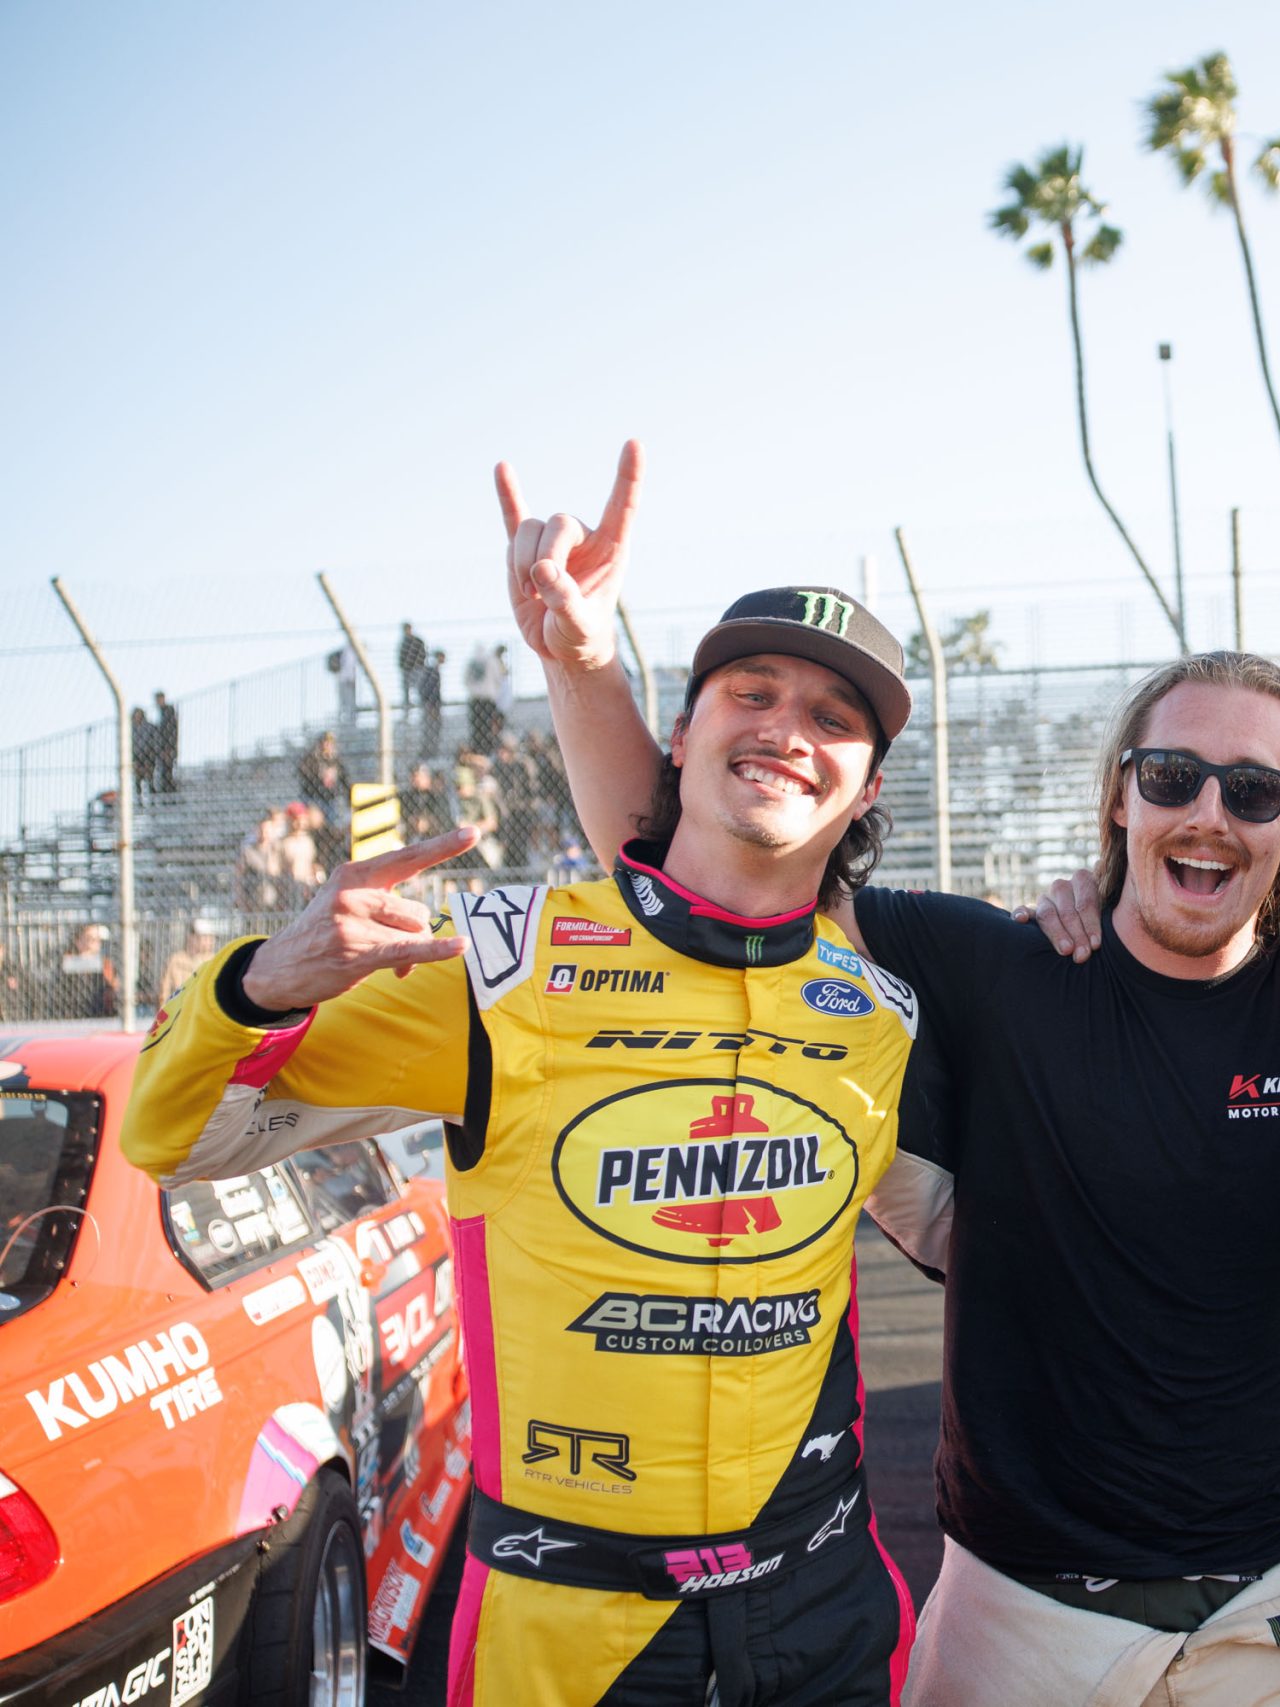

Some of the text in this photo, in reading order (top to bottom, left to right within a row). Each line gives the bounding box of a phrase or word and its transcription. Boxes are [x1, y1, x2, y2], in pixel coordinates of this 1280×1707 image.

[556, 921, 593, 931] FORMULA
[580, 969, 665, 993] OPTIMA
[816, 983, 861, 1012] Ford
[585, 1028, 849, 1060] NITTO
[598, 1134, 827, 1205] PENNZOIL
[582, 1295, 817, 1334] BC RACING
[606, 1330, 805, 1353] CUSTOM COILOVERS
[25, 1321, 209, 1441] KUMHO
[150, 1366, 223, 1430] TIRE
[525, 1468, 633, 1494] RTR VEHICLES
